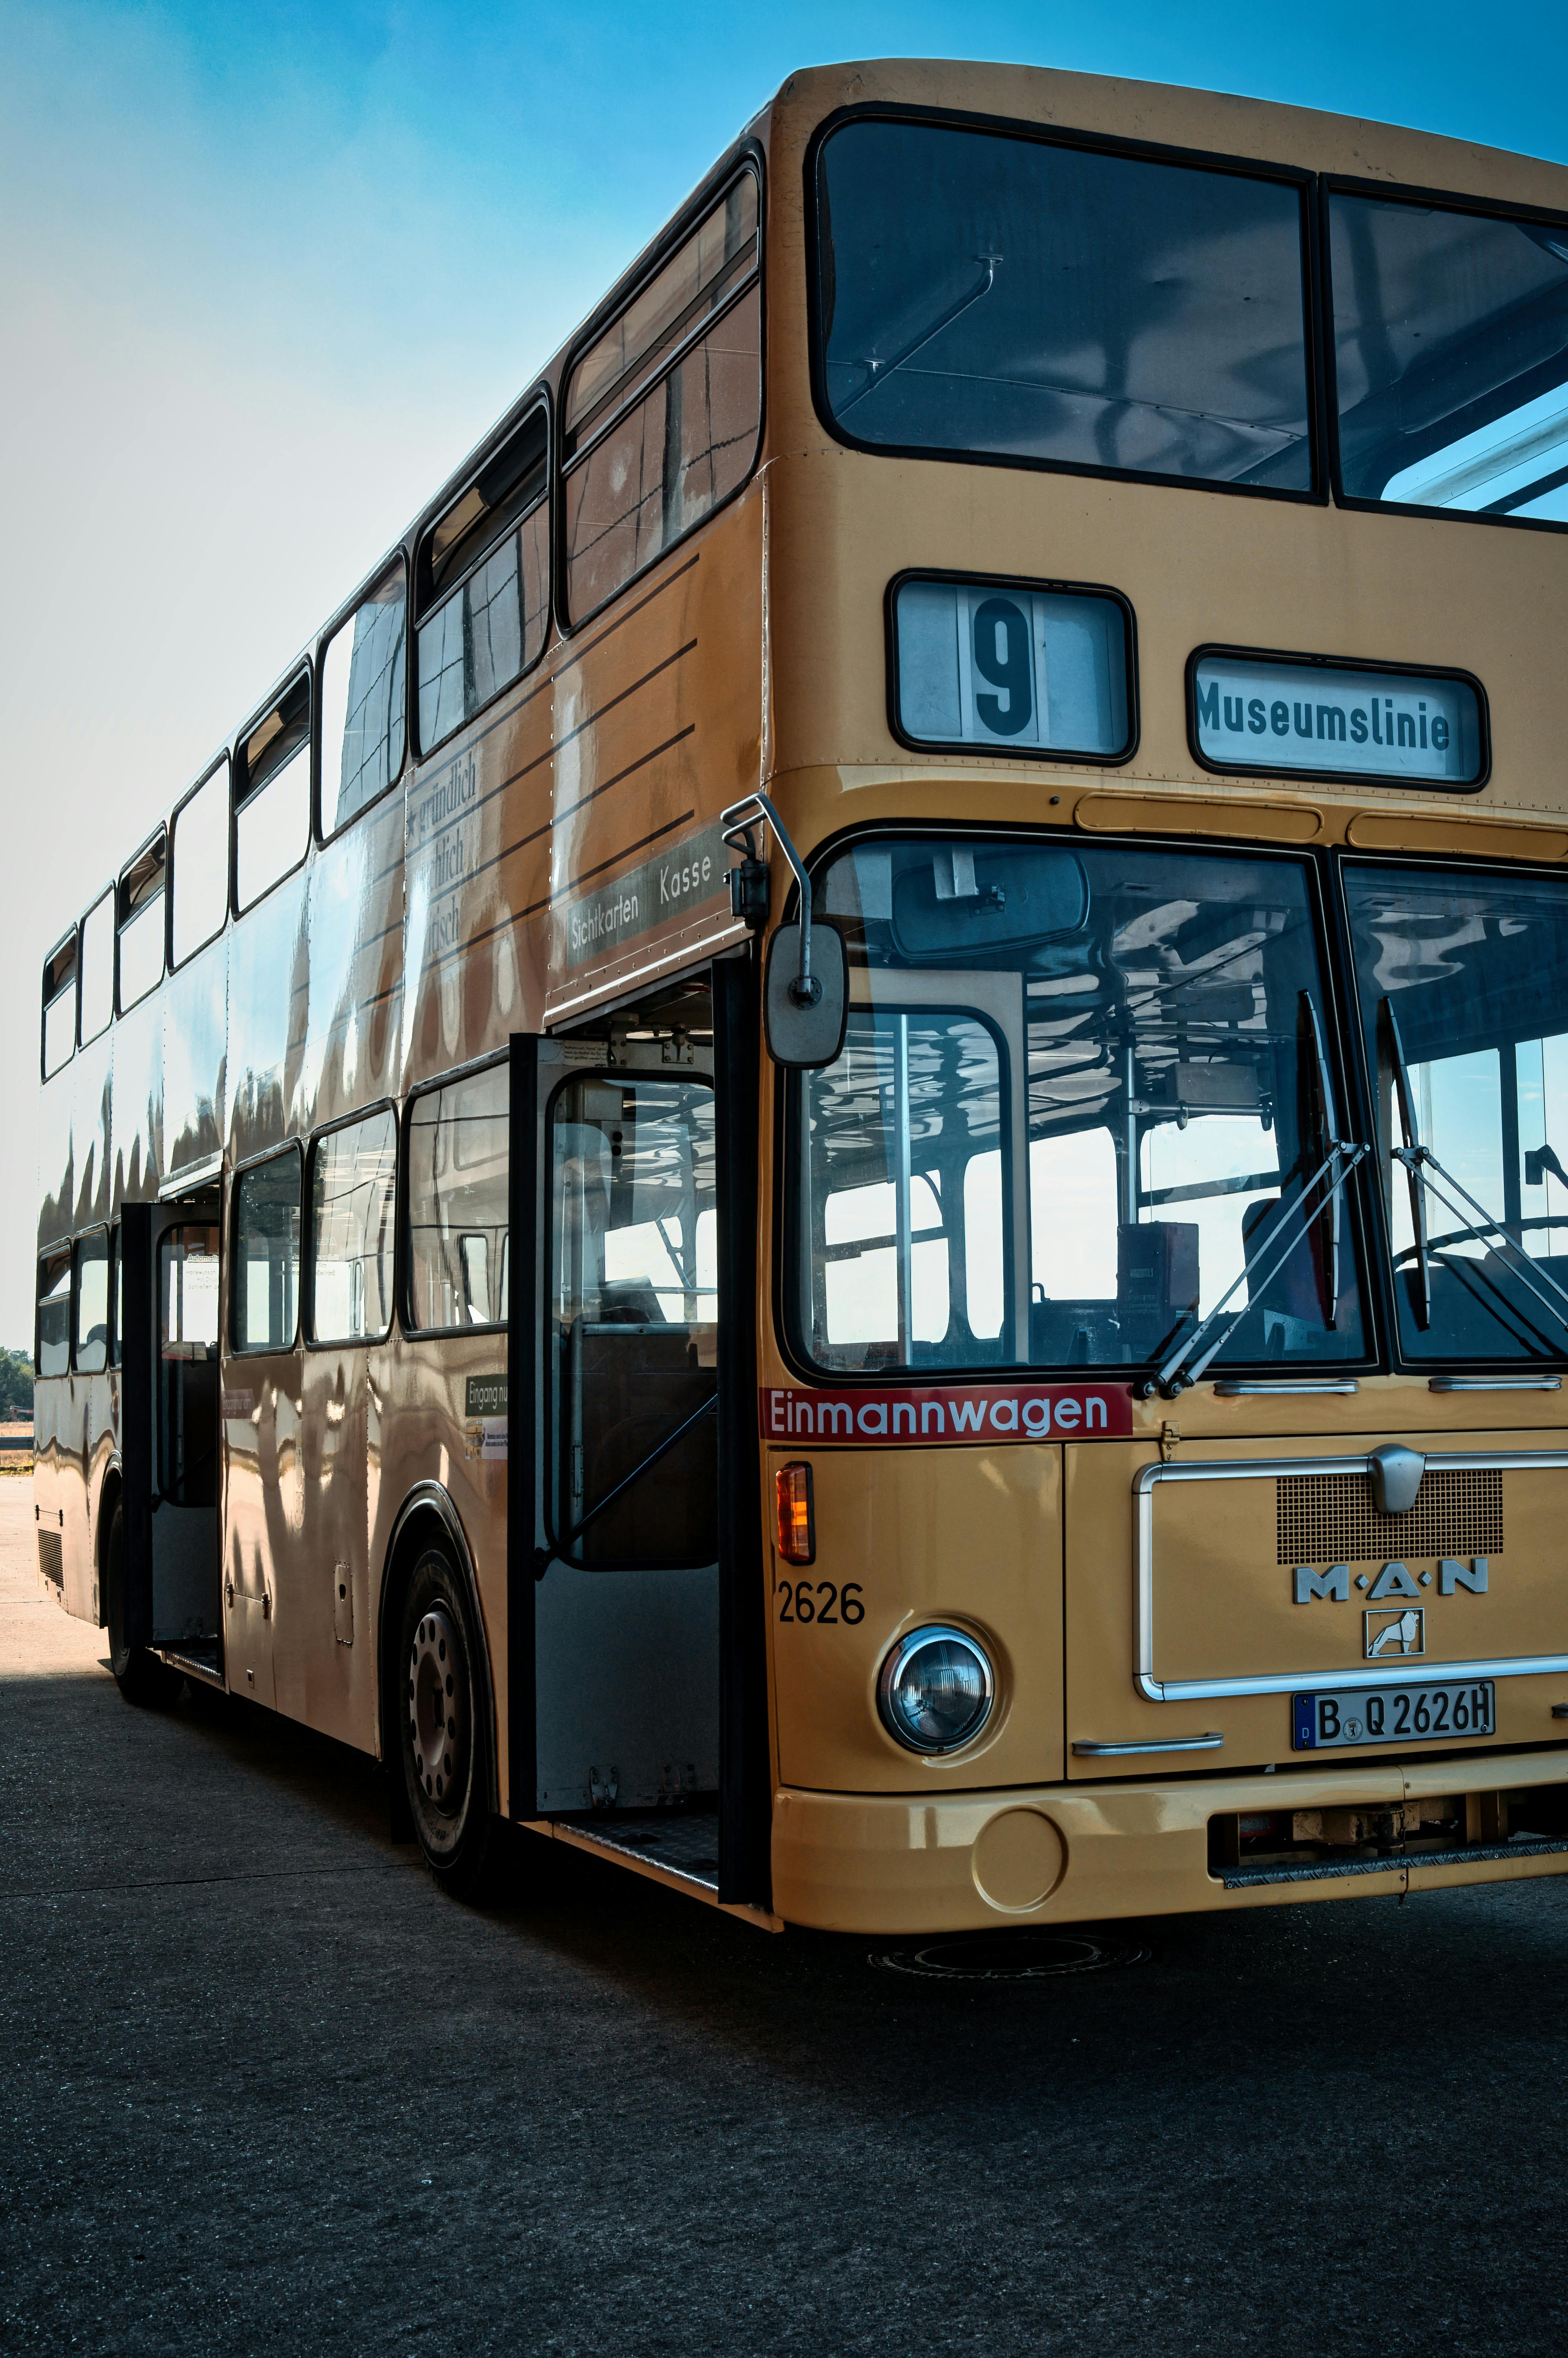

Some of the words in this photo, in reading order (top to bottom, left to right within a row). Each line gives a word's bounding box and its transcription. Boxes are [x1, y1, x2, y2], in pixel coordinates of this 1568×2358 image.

[973, 597, 1032, 736] 9
[1197, 679, 1449, 751] Museumslinie
[420, 751, 476, 839] gründlich
[572, 895, 638, 950] Sichtkarten
[660, 856, 711, 905] Kasse
[469, 1381, 498, 1410] Eingang
[771, 1391, 1107, 1437] Einmannwagen
[778, 1580, 865, 1625] 2626
[1302, 1727, 1309, 1739] D
[1319, 1699, 1341, 1740] B
